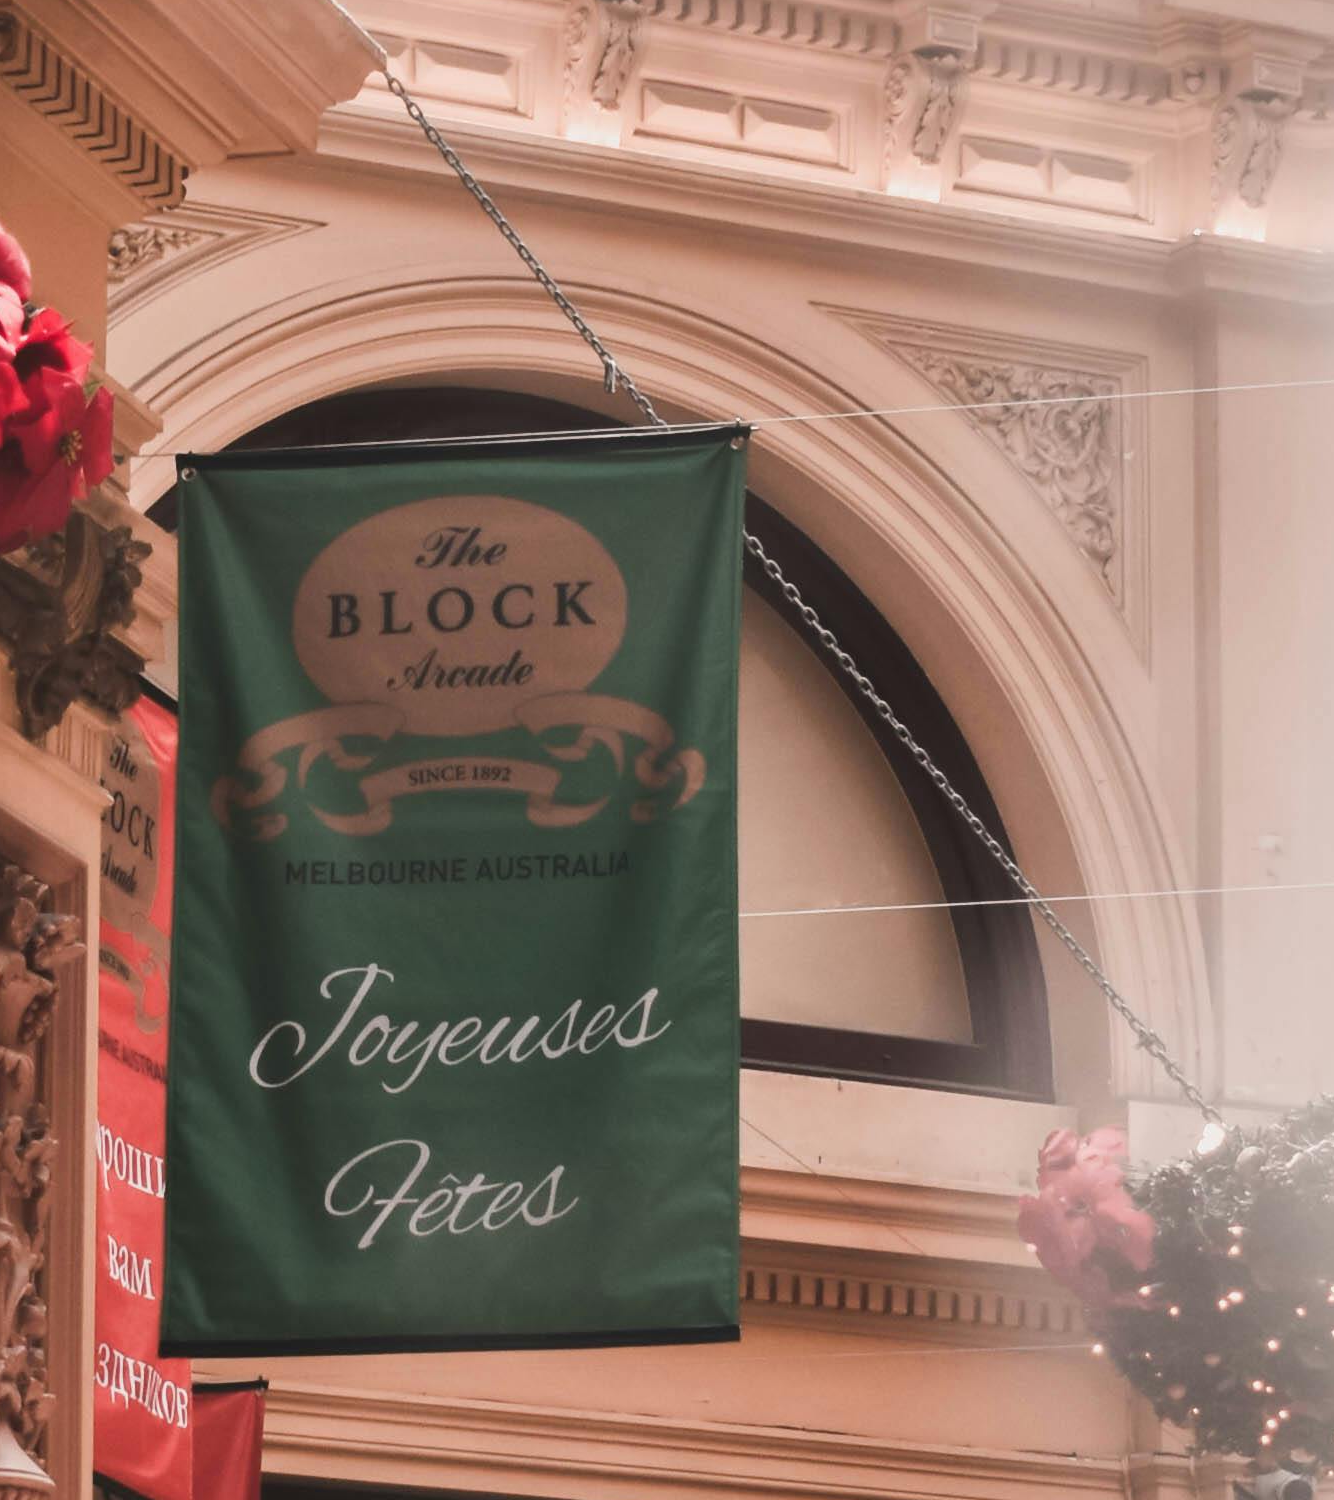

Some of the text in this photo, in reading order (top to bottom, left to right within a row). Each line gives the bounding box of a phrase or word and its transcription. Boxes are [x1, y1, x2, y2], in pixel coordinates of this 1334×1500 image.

[415, 526, 508, 568] The
[327, 580, 596, 638] BLOCK
[386, 648, 534, 691] Arcade
[408, 765, 511, 786] SINCE 1892
[101, 777, 155, 860] OCK
[285, 851, 633, 886] MELBOURNE AUSTRALIA
[249, 962, 672, 1095] Joyeuses
[323, 1139, 579, 1250] Fêtes
[107, 1234, 155, 1301] вам
[97, 1342, 189, 1430] здников
